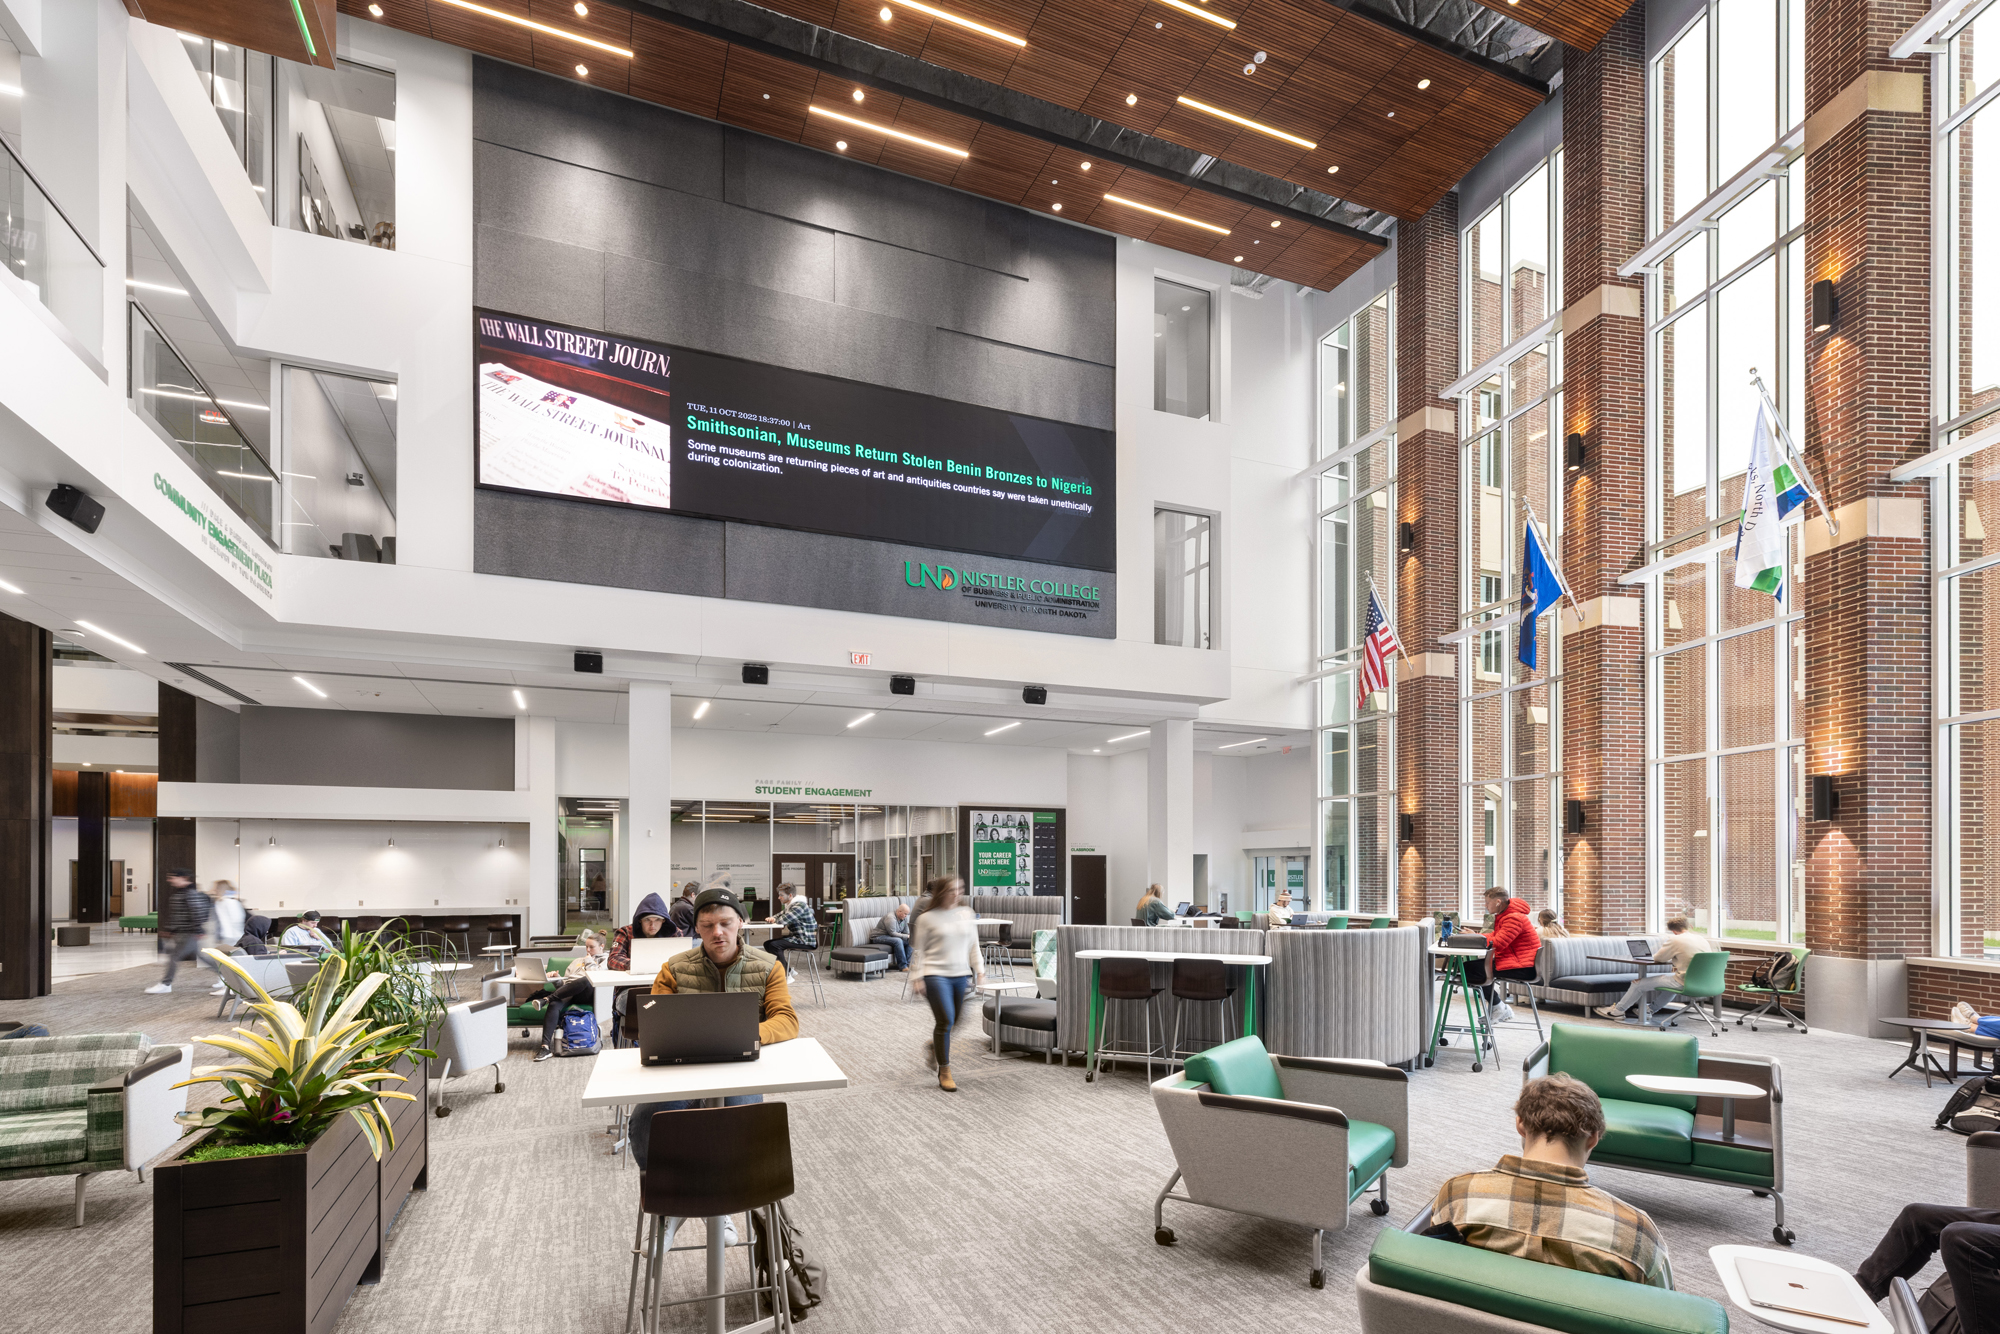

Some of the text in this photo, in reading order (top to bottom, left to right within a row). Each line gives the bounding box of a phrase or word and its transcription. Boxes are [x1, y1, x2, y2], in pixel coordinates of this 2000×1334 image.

[480, 317, 671, 378] THE WALL STREET JOURN
[481, 381, 510, 396] THE
[507, 392, 541, 414] WALL
[542, 407, 601, 435] STREET
[687, 402, 708, 414] TUE,
[709, 406, 718, 414] 11
[719, 408, 737, 418] OCT
[738, 411, 757, 421] 2022
[758, 415, 790, 427] 18:37:00
[798, 422, 811, 430] Art
[687, 415, 1092, 495] Smithsonian, Museums Return Stolen Benin Bronzes to Nigeria
[687, 452, 783, 475] during colonization.
[688, 439, 1093, 514] Some museums are returning pieces of art and antiquities countries say were taken unethically
[1750, 484, 1766, 518] North
[154, 472, 207, 530] COMMUNITY
[208, 520, 254, 572] ENGAGEMENT
[254, 562, 273, 589] PLAZA
[904, 561, 959, 591] UND
[962, 570, 1100, 601] NISTLER COLLEGE
[973, 587, 1009, 598] BUSINESS
[1017, 592, 1042, 603] PUBLIC
[1043, 596, 1100, 608] ADMINISTRATION
[975, 600, 1087, 619] UNIVERSITY OF NORTH DAKOTA
[854, 654, 869, 665] EXIT
[755, 786, 872, 797] STUDENT ENGAGEMENT
